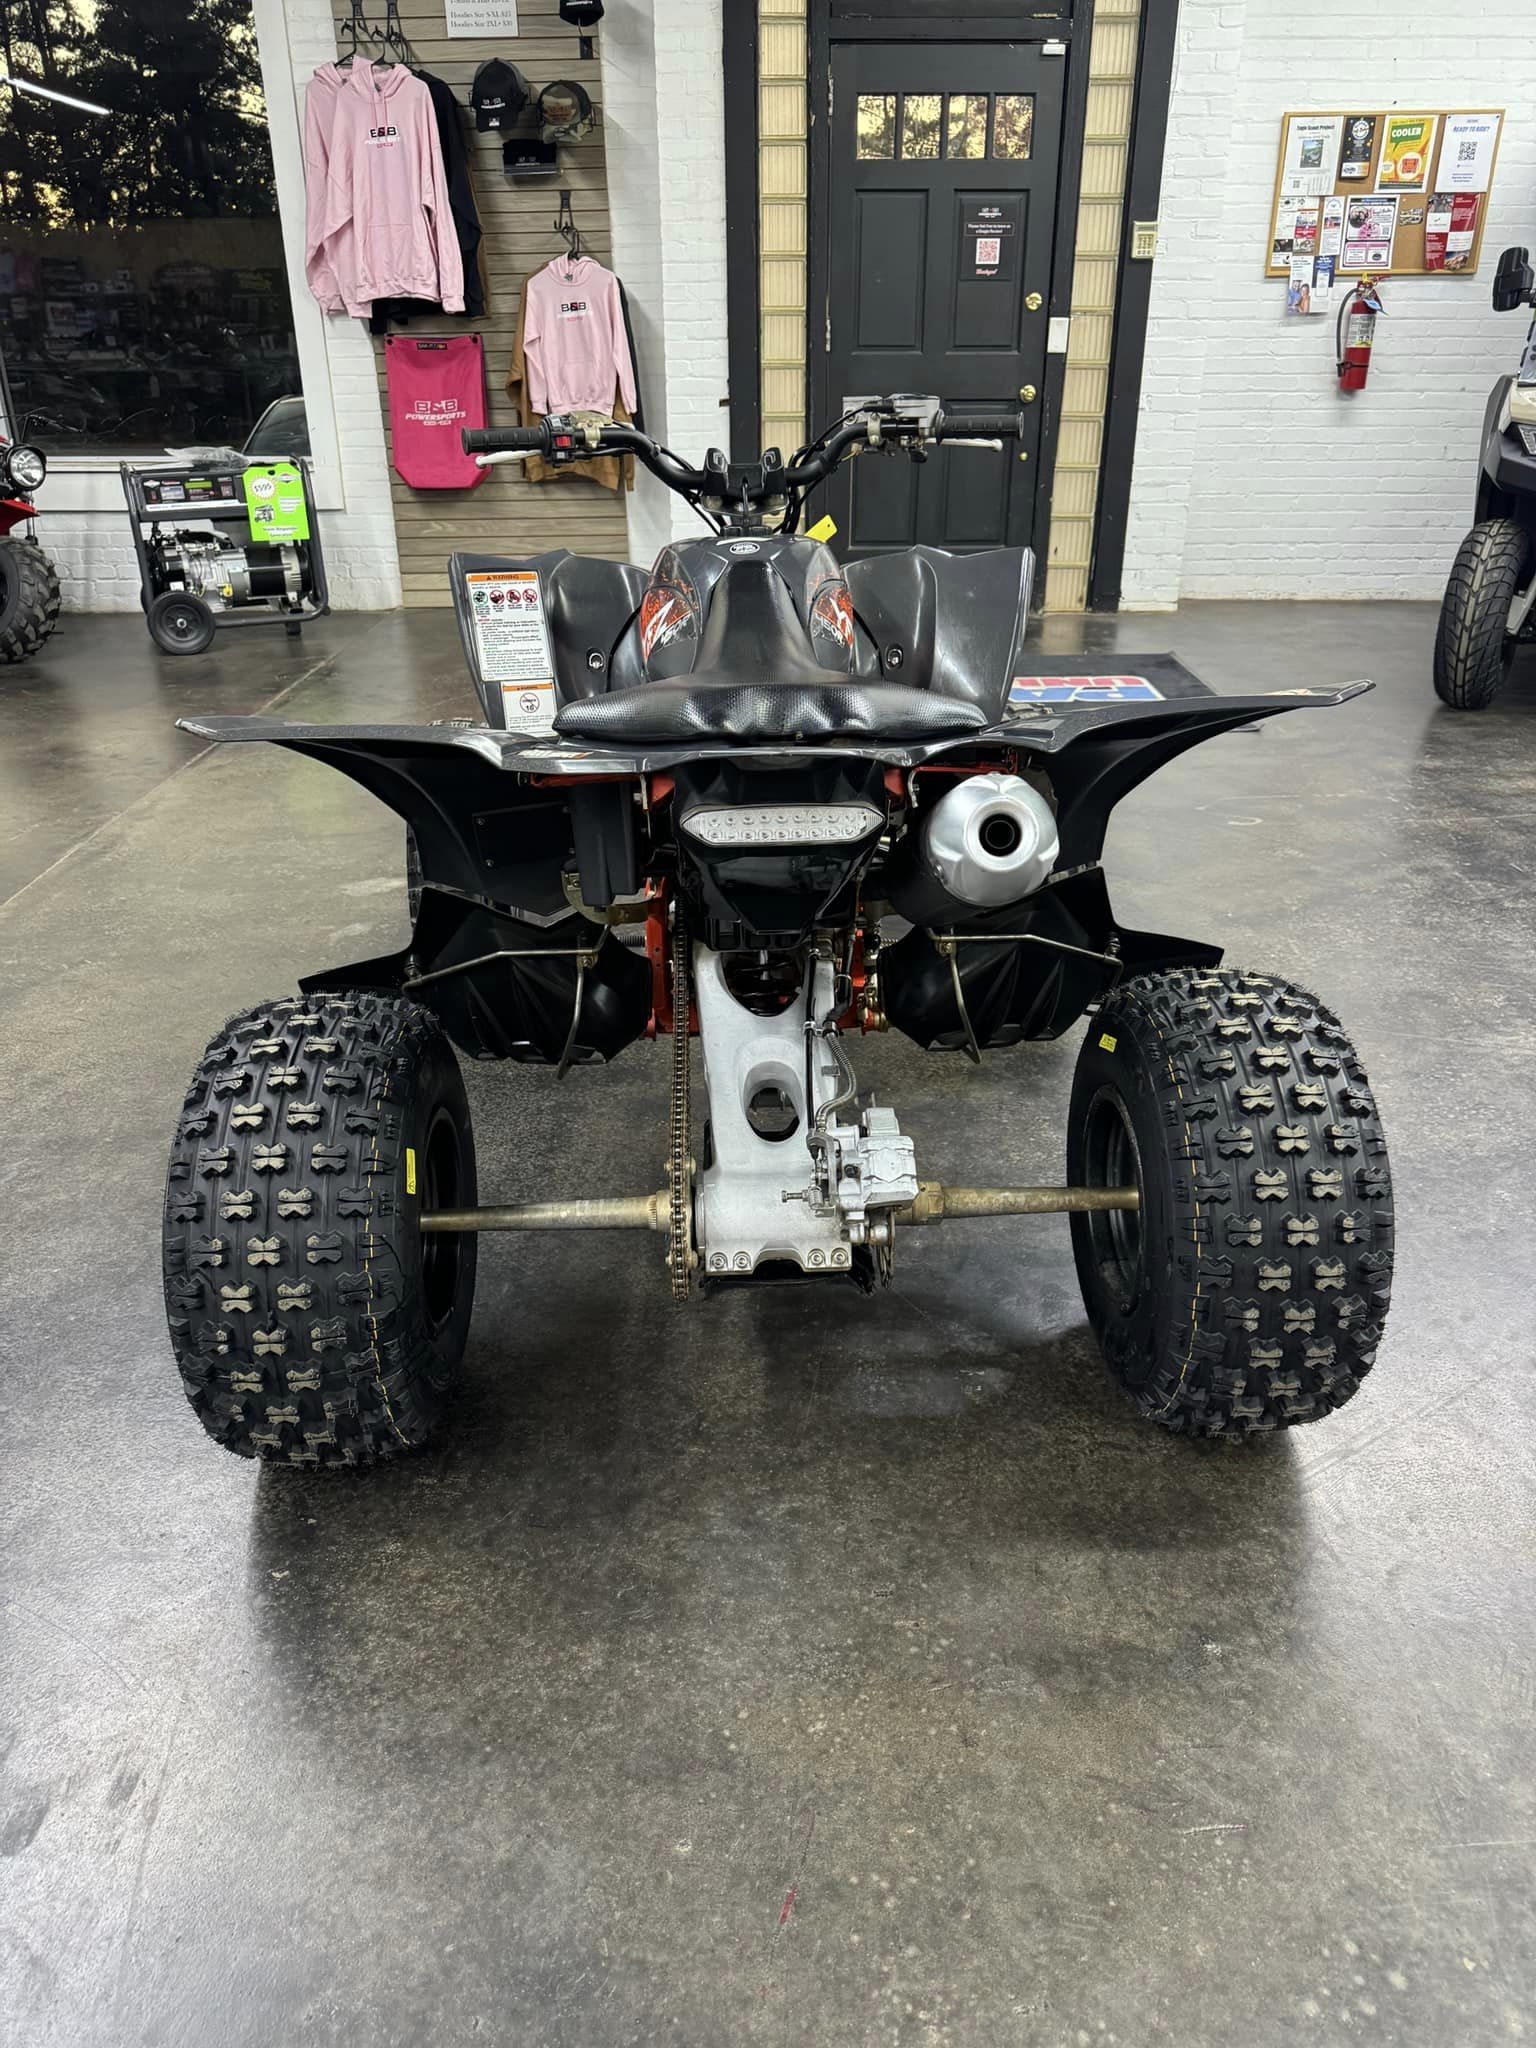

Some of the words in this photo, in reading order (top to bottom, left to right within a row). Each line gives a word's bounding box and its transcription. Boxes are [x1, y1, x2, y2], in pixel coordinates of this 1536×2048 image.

[1391, 127, 1423, 138] COOLER
[560, 301, 587, 312] B&B
[404, 411, 467, 421] POWERSPORTS
